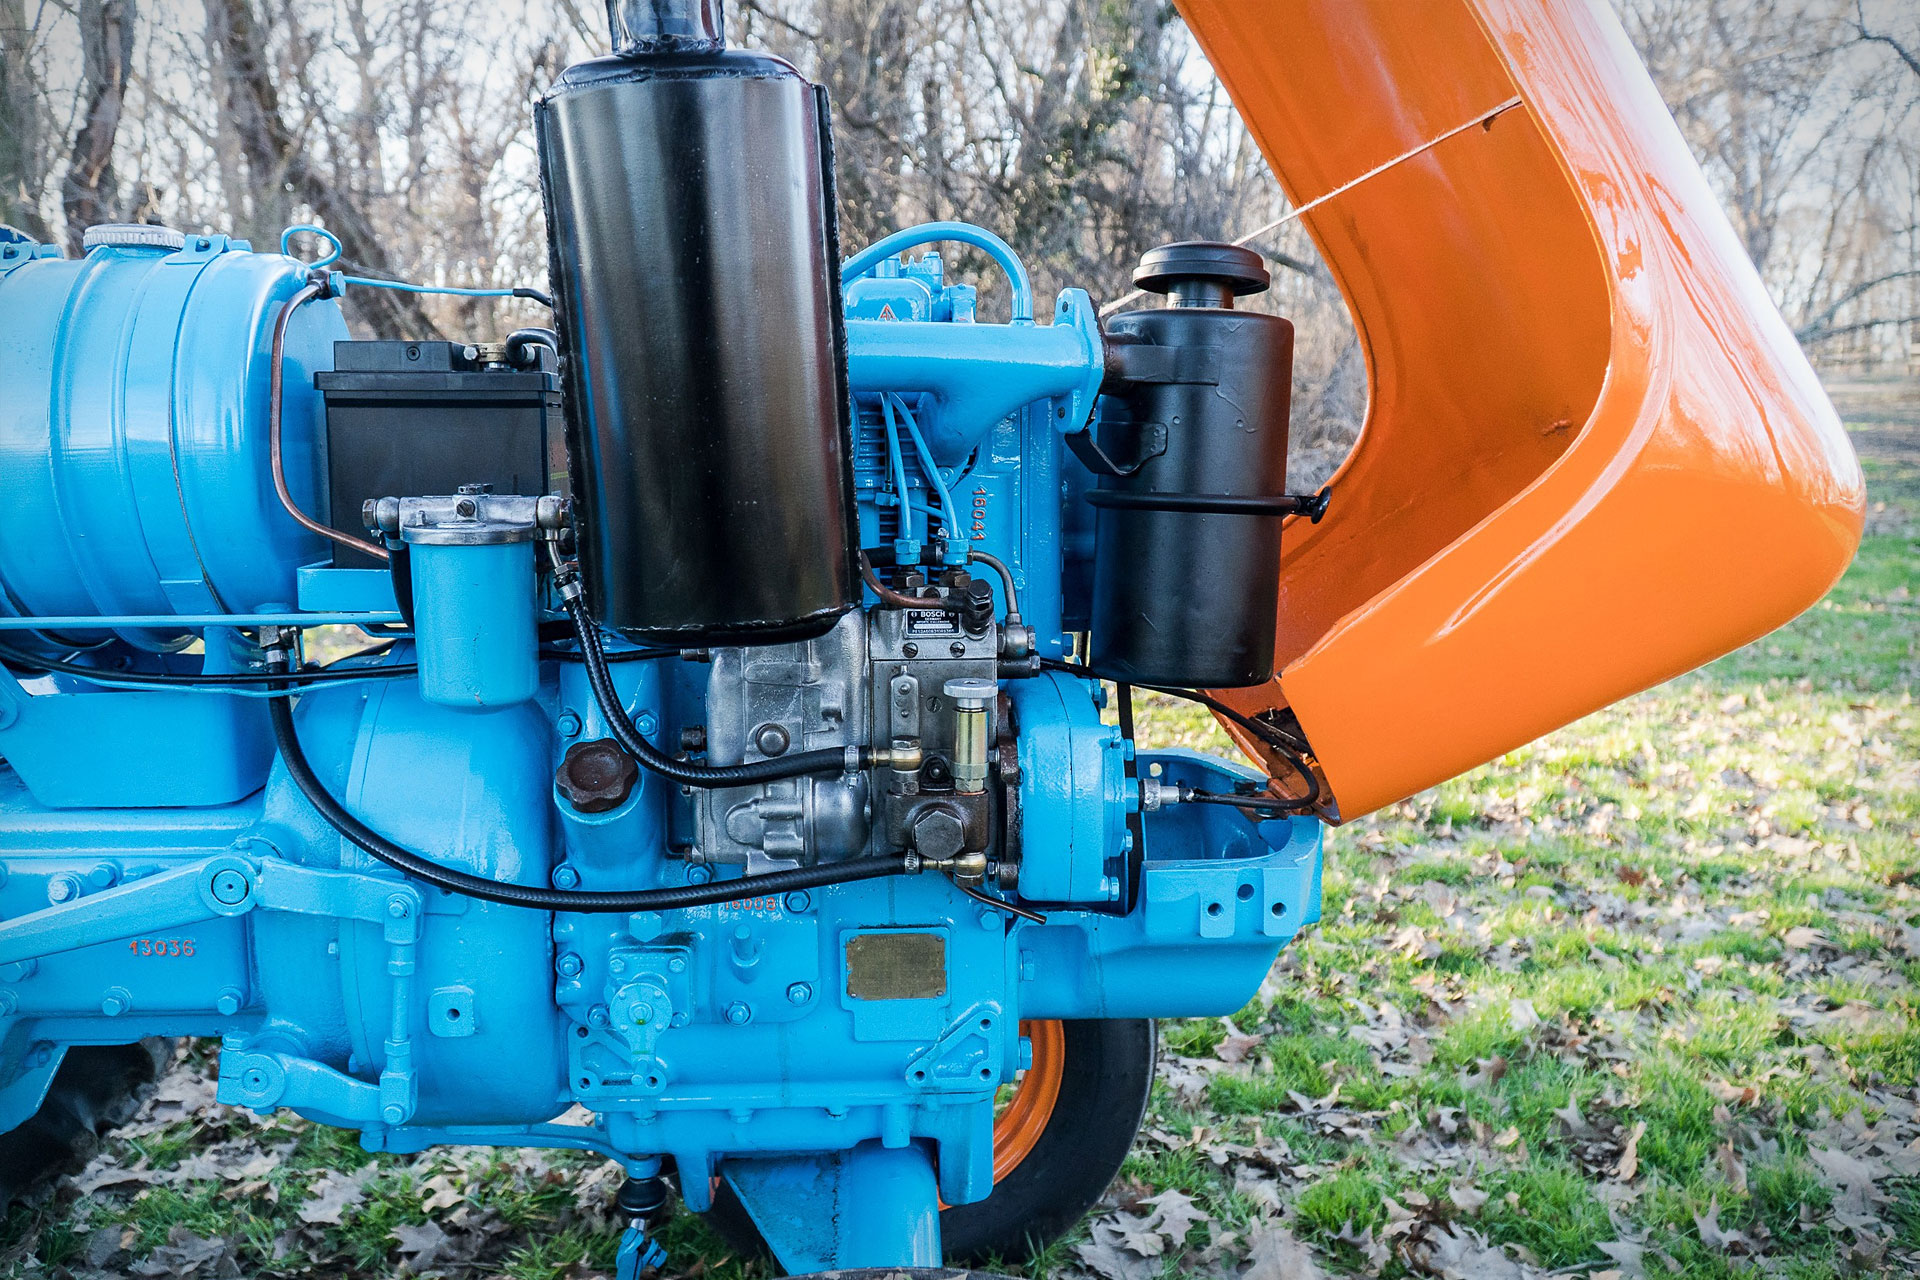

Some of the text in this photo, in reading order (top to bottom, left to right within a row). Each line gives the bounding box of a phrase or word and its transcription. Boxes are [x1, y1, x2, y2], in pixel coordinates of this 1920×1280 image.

[973, 487, 986, 540] 16041
[725, 897, 776, 911] 16008
[129, 940, 194, 957] 13036
